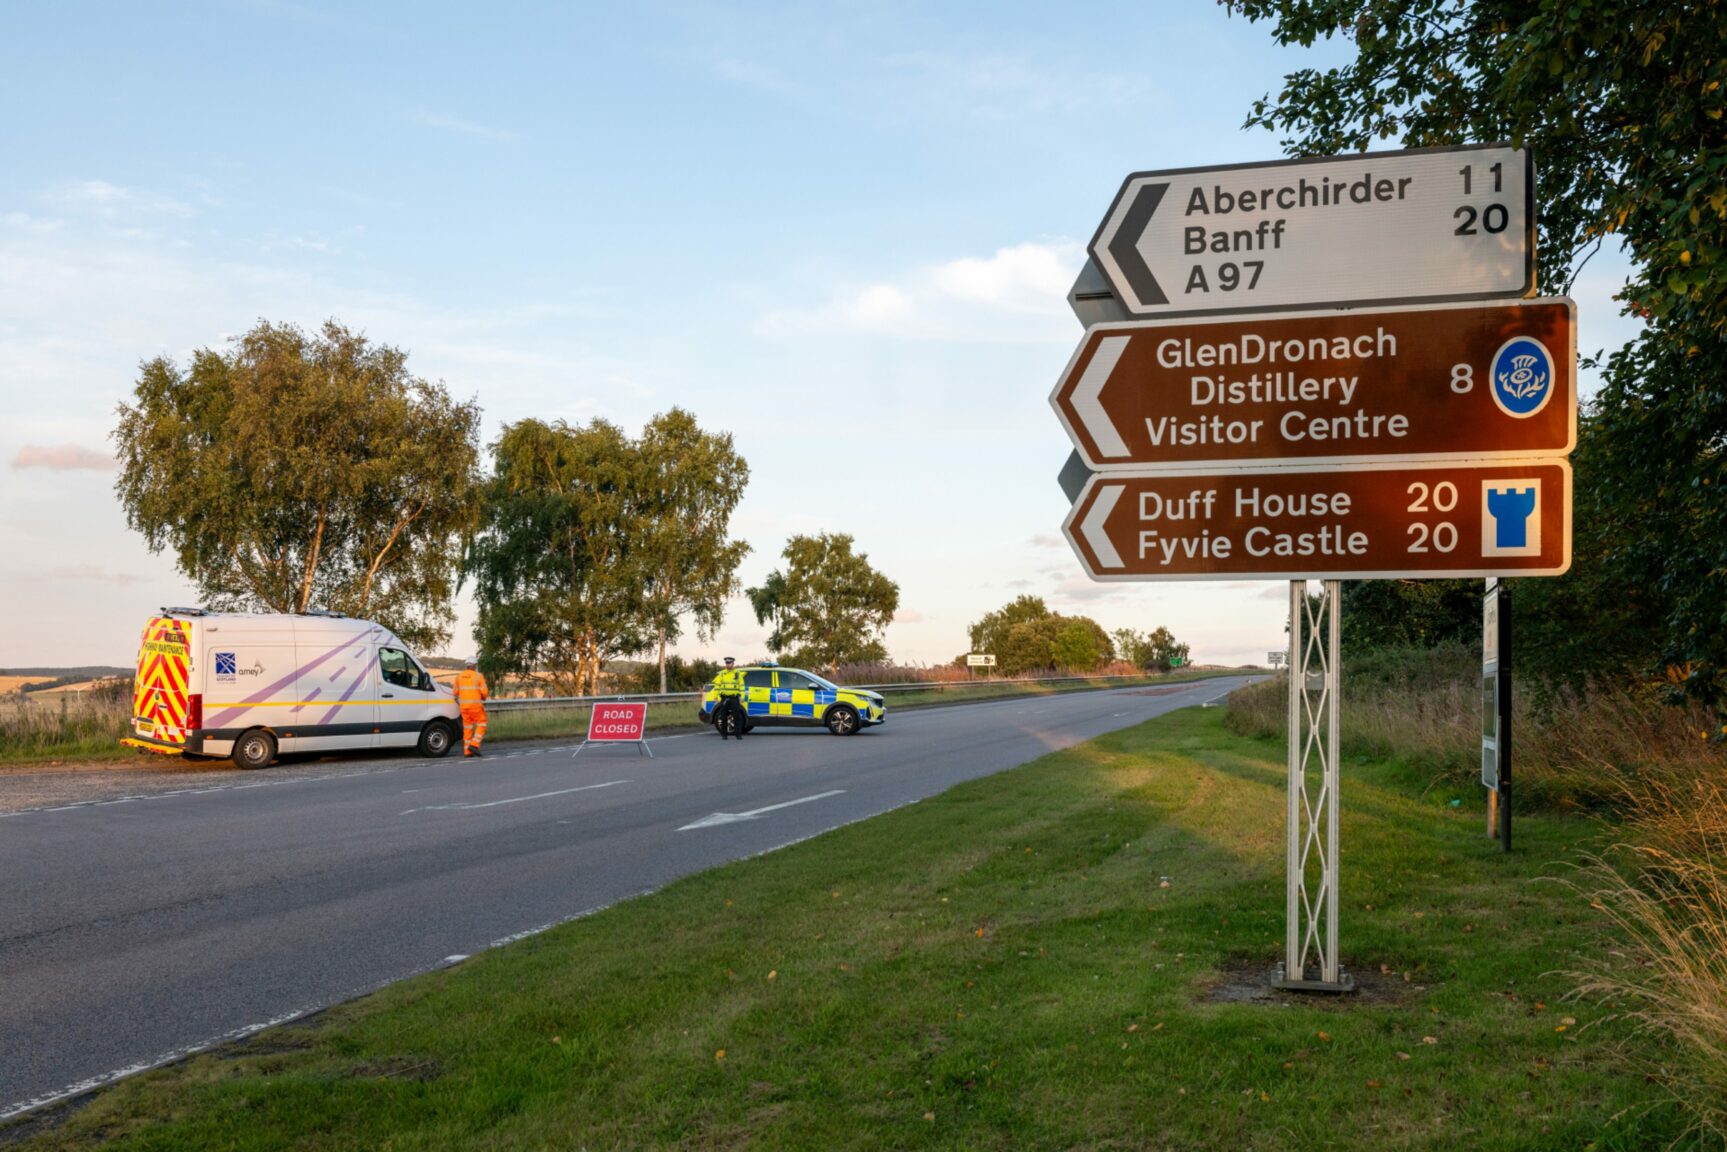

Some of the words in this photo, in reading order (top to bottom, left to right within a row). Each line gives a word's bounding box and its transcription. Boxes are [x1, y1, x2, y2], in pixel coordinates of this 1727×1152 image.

[1184, 173, 1413, 217] Aberchirder
[1459, 161, 1503, 195] 11
[1184, 218, 1286, 255] Banff
[1453, 203, 1510, 236] 20
[1184, 260, 1265, 294] A97
[1156, 326, 1397, 369] GlenDronach
[1191, 371, 1359, 406] Distillery
[1450, 362, 1474, 394] 8
[1144, 415, 1264, 446] Visitor
[1279, 408, 1409, 442] Centre
[1139, 489, 1217, 521] Duff
[1235, 487, 1352, 518] House
[1406, 480, 1459, 513] 20
[1138, 529, 1232, 566] Fyvie
[1244, 524, 1369, 557] Castle
[1406, 521, 1459, 553] 20
[594, 724, 638, 734] CLOSED
[603, 710, 634, 720] ROAD
